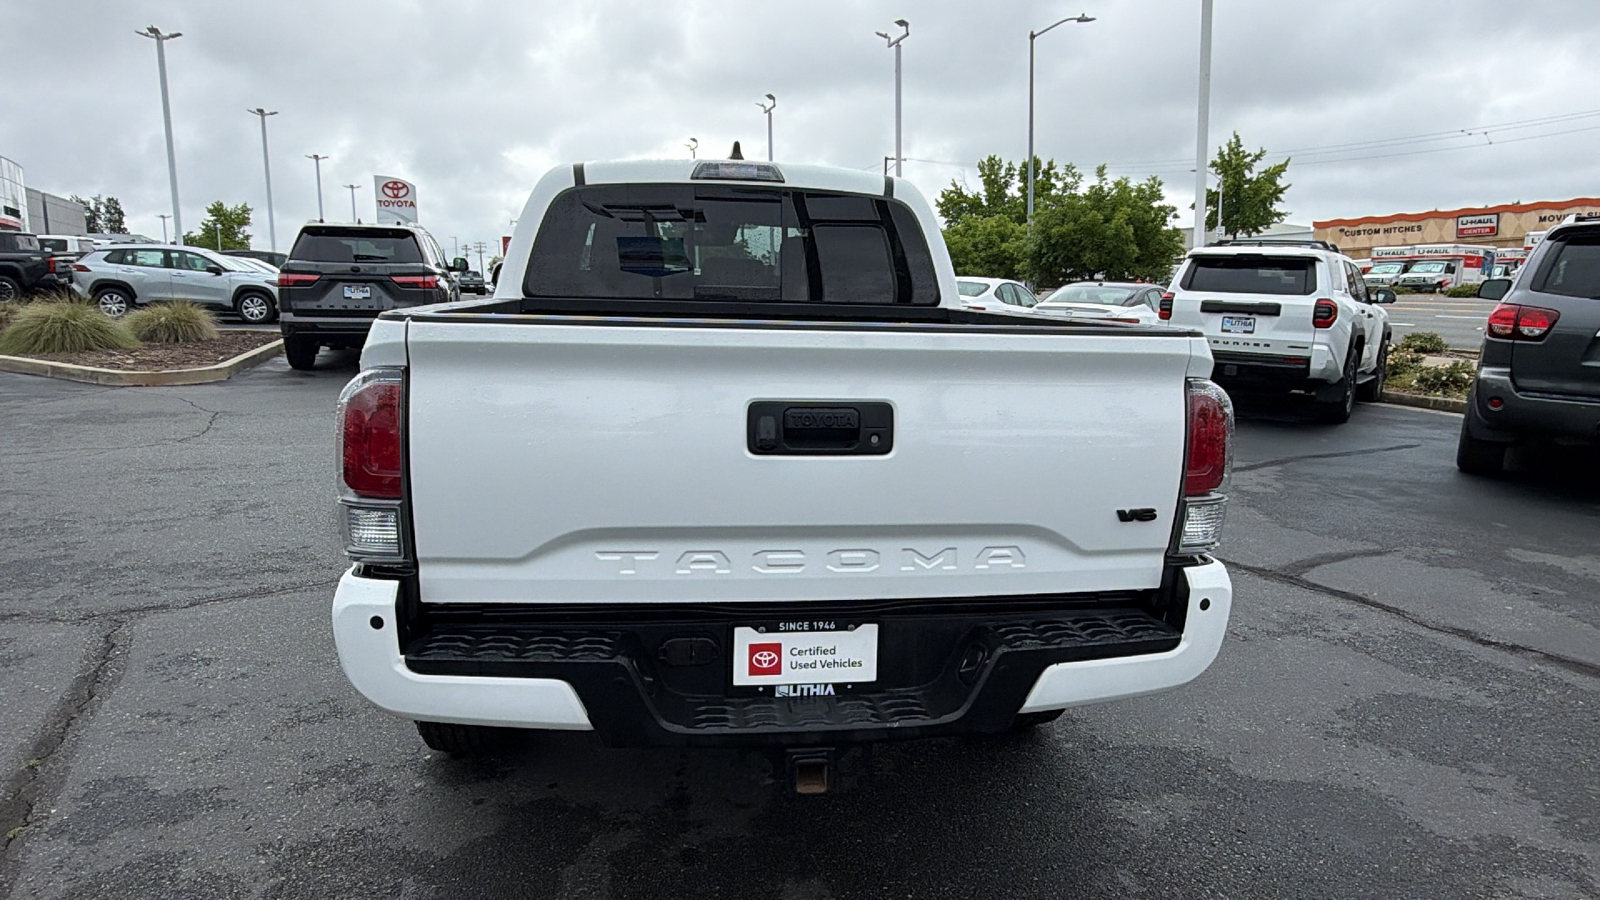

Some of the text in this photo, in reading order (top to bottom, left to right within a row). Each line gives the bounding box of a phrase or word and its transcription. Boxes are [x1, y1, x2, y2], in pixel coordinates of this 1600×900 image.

[377, 200, 416, 208] TOYOTA
[1461, 218, 1494, 226] U-HAUL
[1344, 225, 1422, 237] CUSTOM HITCHES
[791, 412, 855, 428] TOYOTA
[1116, 507, 1158, 523] V6
[595, 546, 1026, 575] TACOMA
[779, 621, 836, 631] SINCE 1946
[789, 645, 837, 657] Certified
[790, 658, 863, 670] Used Vehicles
[789, 684, 836, 697] LITHIA
